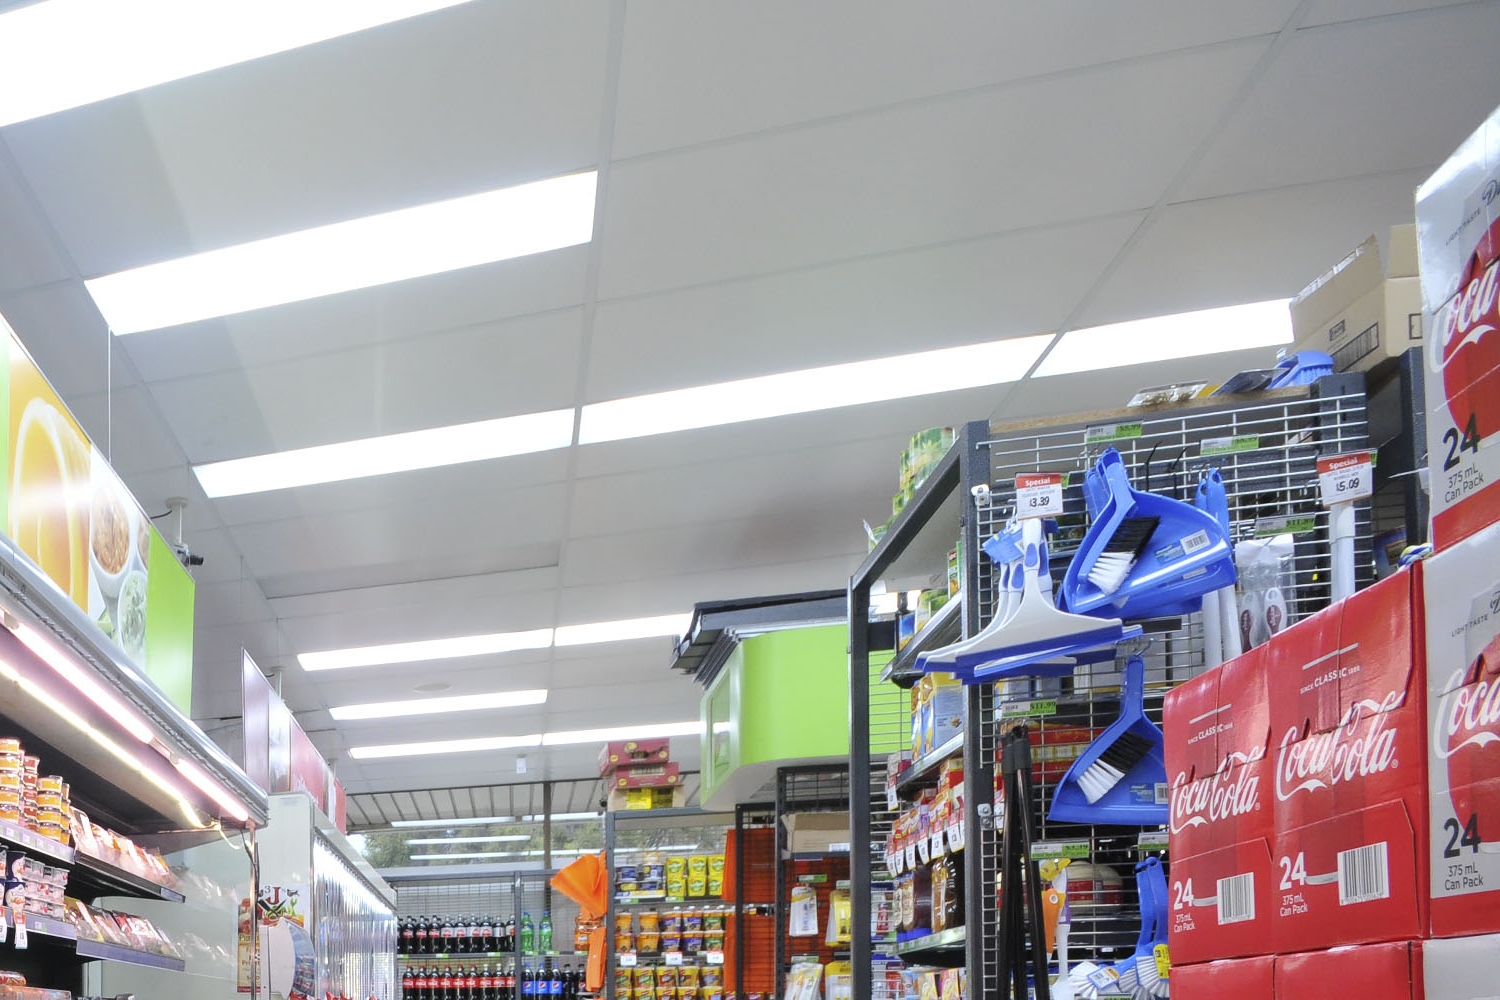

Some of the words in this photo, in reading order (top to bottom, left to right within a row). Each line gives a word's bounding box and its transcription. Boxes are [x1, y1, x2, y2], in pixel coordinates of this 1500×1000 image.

[1442, 412, 1481, 473] 24
[1328, 456, 1359, 470] Special
[1336, 477, 1360, 493] $5.09
[1444, 485, 1462, 504] Can
[1461, 473, 1485, 496] Pack
[1197, 723, 1224, 741] CLASSIC
[1442, 812, 1482, 859] 24
[1279, 852, 1307, 891] 24
[1448, 863, 1466, 877] 375
[1465, 861, 1480, 875] mL
[1172, 877, 1195, 912] 24
[1444, 877, 1462, 891] Can
[1461, 874, 1484, 890] Pack
